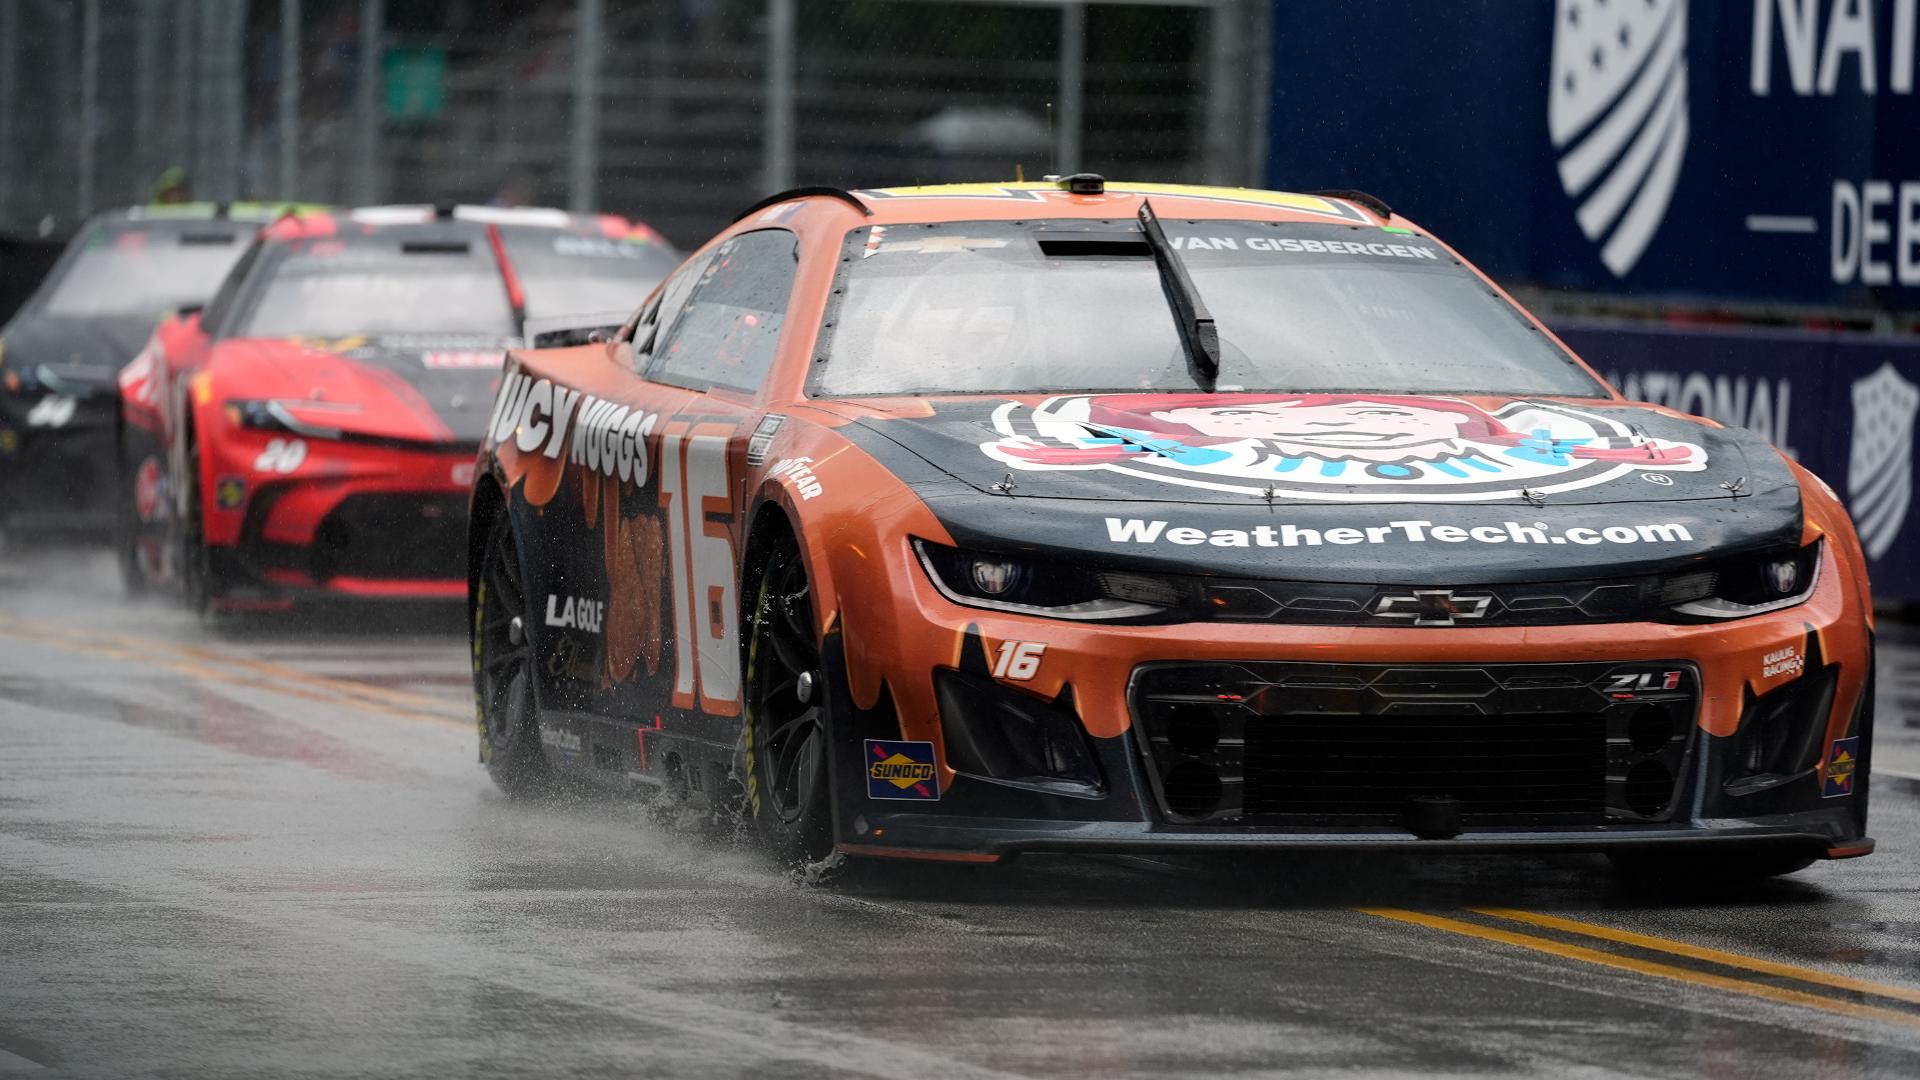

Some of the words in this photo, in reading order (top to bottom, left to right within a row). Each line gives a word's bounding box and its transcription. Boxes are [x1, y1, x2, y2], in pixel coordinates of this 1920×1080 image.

[1168, 235, 1240, 251] VAN
[1245, 236, 1439, 260] GISBERGEN
[571, 394, 658, 488] NUGGS
[659, 426, 742, 716] 16
[545, 594, 576, 629] LA
[577, 597, 603, 634] GOLF
[992, 640, 1048, 681] 16
[1602, 670, 1681, 693] ZL1
[873, 763, 931, 779] SUNOCO
